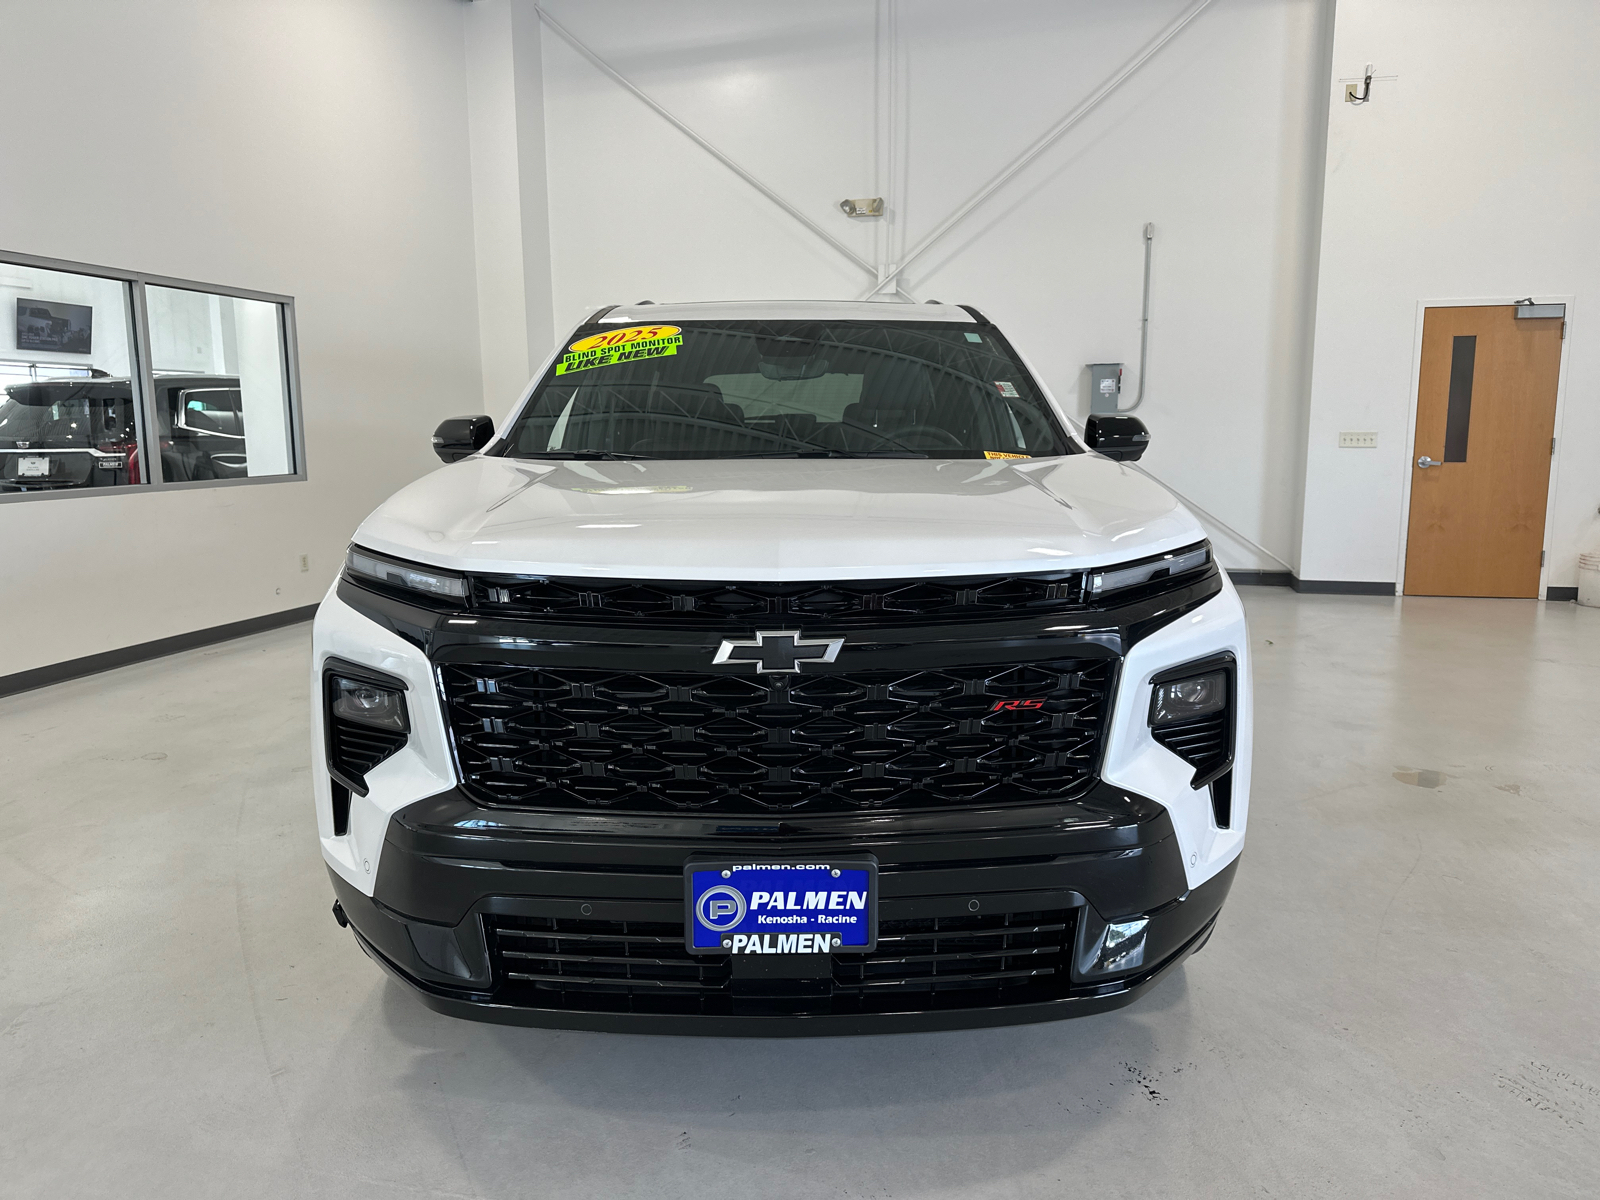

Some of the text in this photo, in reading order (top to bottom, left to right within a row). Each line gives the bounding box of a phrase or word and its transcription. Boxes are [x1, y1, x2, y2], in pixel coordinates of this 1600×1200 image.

[587, 326, 662, 349] 2025
[564, 345, 669, 373] LIKE NEW
[565, 336, 681, 363] BLIND SPOT MONITOR
[993, 698, 1046, 711] RS
[732, 863, 830, 872] palmen.com
[710, 900, 736, 919] P
[750, 891, 867, 910] PALMEN
[757, 914, 807, 924] Kenosha
[818, 914, 857, 924] Racine
[732, 934, 831, 954] PALMEN
